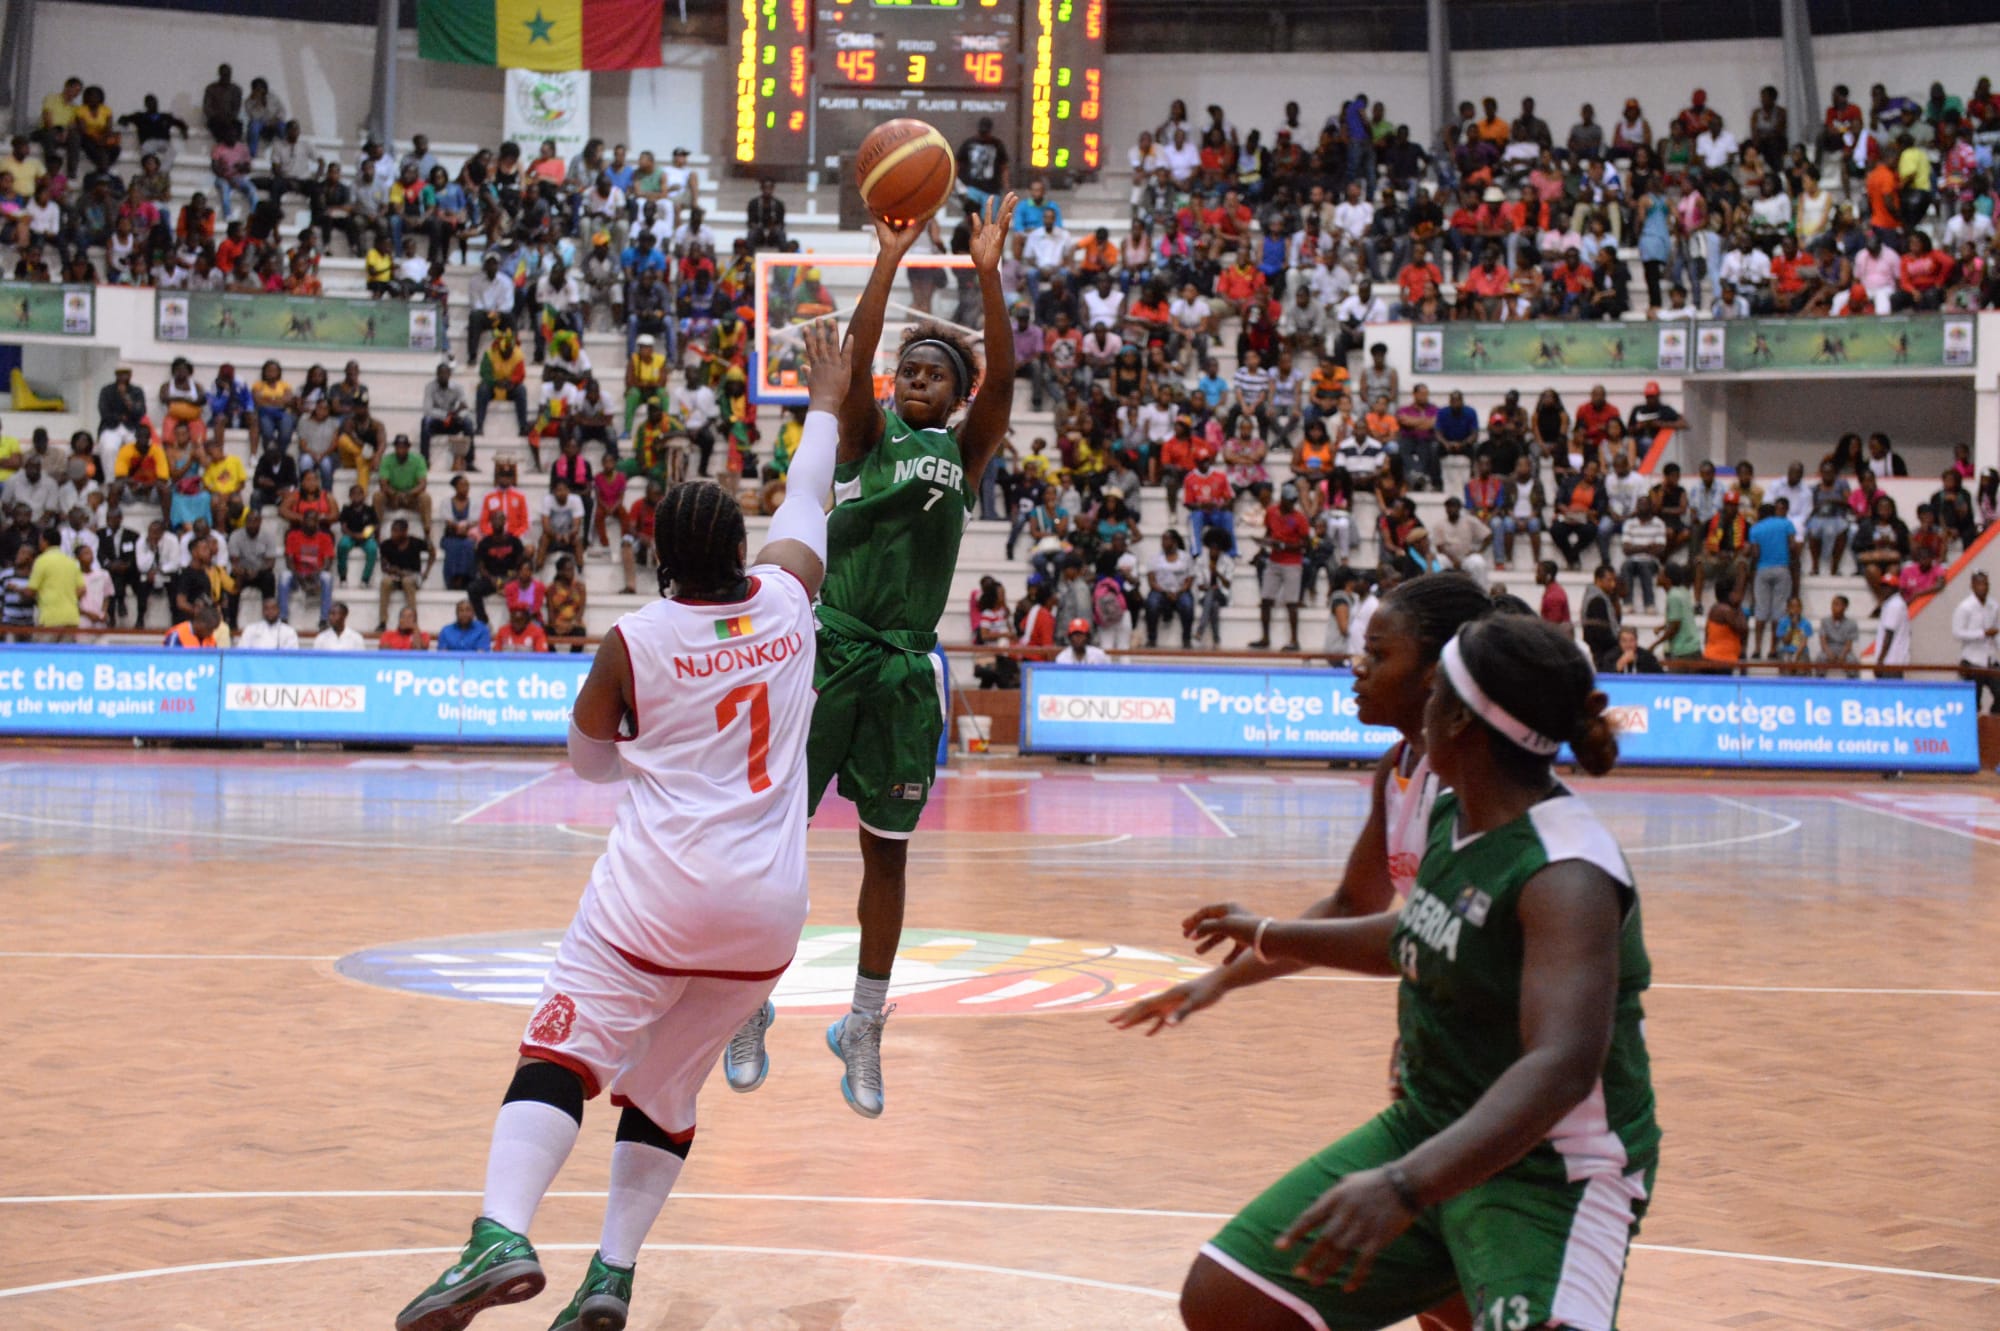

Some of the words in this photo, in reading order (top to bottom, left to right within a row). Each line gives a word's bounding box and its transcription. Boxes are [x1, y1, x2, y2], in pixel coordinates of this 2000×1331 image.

[1058, 3, 1072, 21] 2
[762, 45, 776, 65] 3
[897, 40, 936, 52] PERIOD
[836, 50, 876, 82] 45
[907, 55, 926, 83] 3
[965, 52, 1003, 84] 46
[761, 77, 776, 97] 2
[1057, 68, 1071, 87] 3
[819, 98, 858, 109] PLAYER
[1056, 99, 1070, 119] 3
[789, 111, 805, 131] 2
[1055, 148, 1070, 168] 2
[893, 455, 964, 495] NIGER
[922, 487, 944, 512] 7
[673, 632, 802, 680] NJONKOU
[34, 664, 84, 691] the
[517, 673, 567, 699] the
[17, 697, 42, 713] the
[48, 697, 94, 714] world
[97, 698, 155, 718] against
[160, 697, 196, 713] AIDS
[262, 687, 357, 710] UNAIDS
[1332, 690, 1360, 716] le
[438, 703, 497, 725] Uniting
[502, 705, 527, 721] the
[1068, 699, 1172, 721] ONUSIDA
[1805, 699, 1832, 726] le
[715, 681, 773, 794] 7
[1243, 725, 1281, 742] Unir
[1286, 725, 1299, 741] le
[1304, 727, 1359, 743] monde
[1717, 734, 1754, 752] Unir
[1759, 734, 1773, 751] le
[1778, 736, 1833, 753] monde
[1837, 737, 1890, 754] contre
[1894, 737, 1909, 754] le
[1913, 739, 1950, 754] SIDA
[1489, 1294, 1530, 1331] 13
